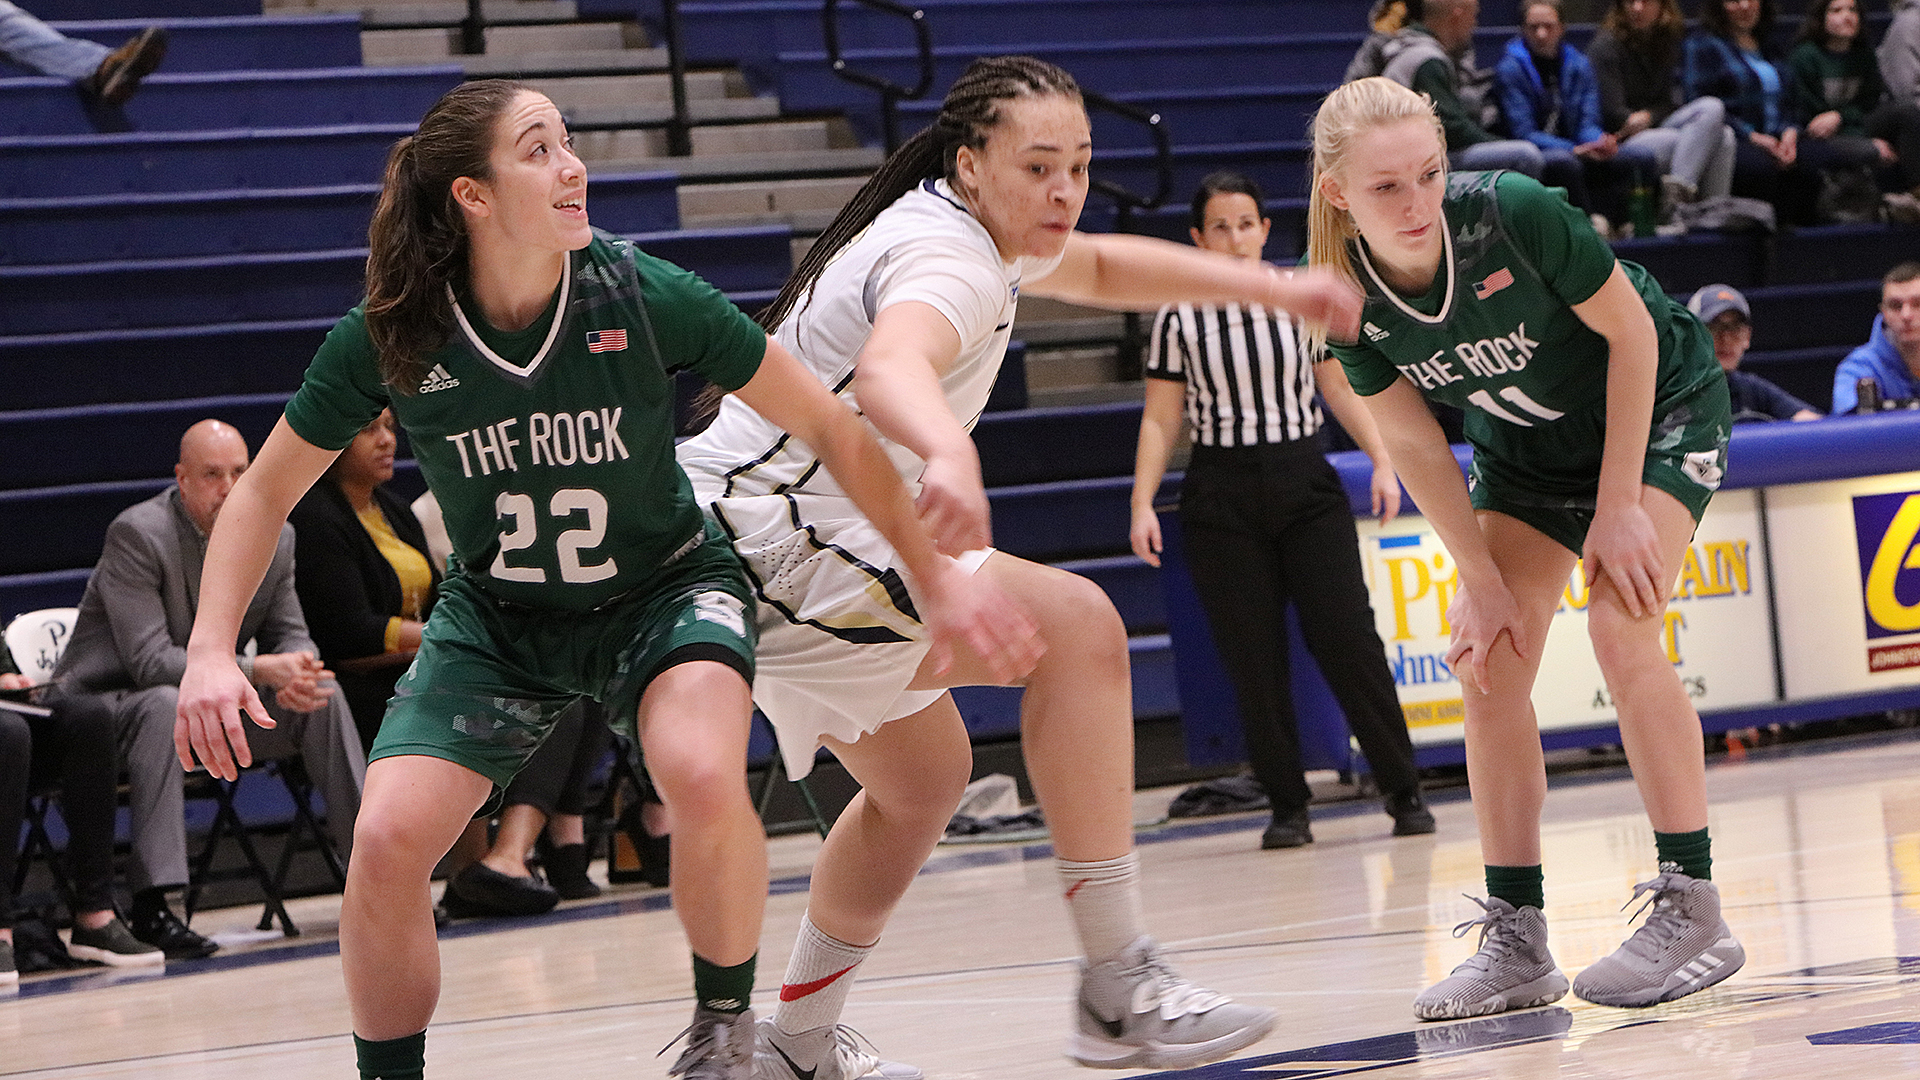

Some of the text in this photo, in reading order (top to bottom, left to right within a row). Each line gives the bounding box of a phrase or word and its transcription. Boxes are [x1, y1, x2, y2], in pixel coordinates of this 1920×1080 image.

[419, 378, 460, 394] adidas
[1396, 321, 1540, 391] THE ROCK
[1467, 386, 1566, 427] 11
[446, 406, 630, 478] THE ROCK
[490, 488, 619, 584] 22
